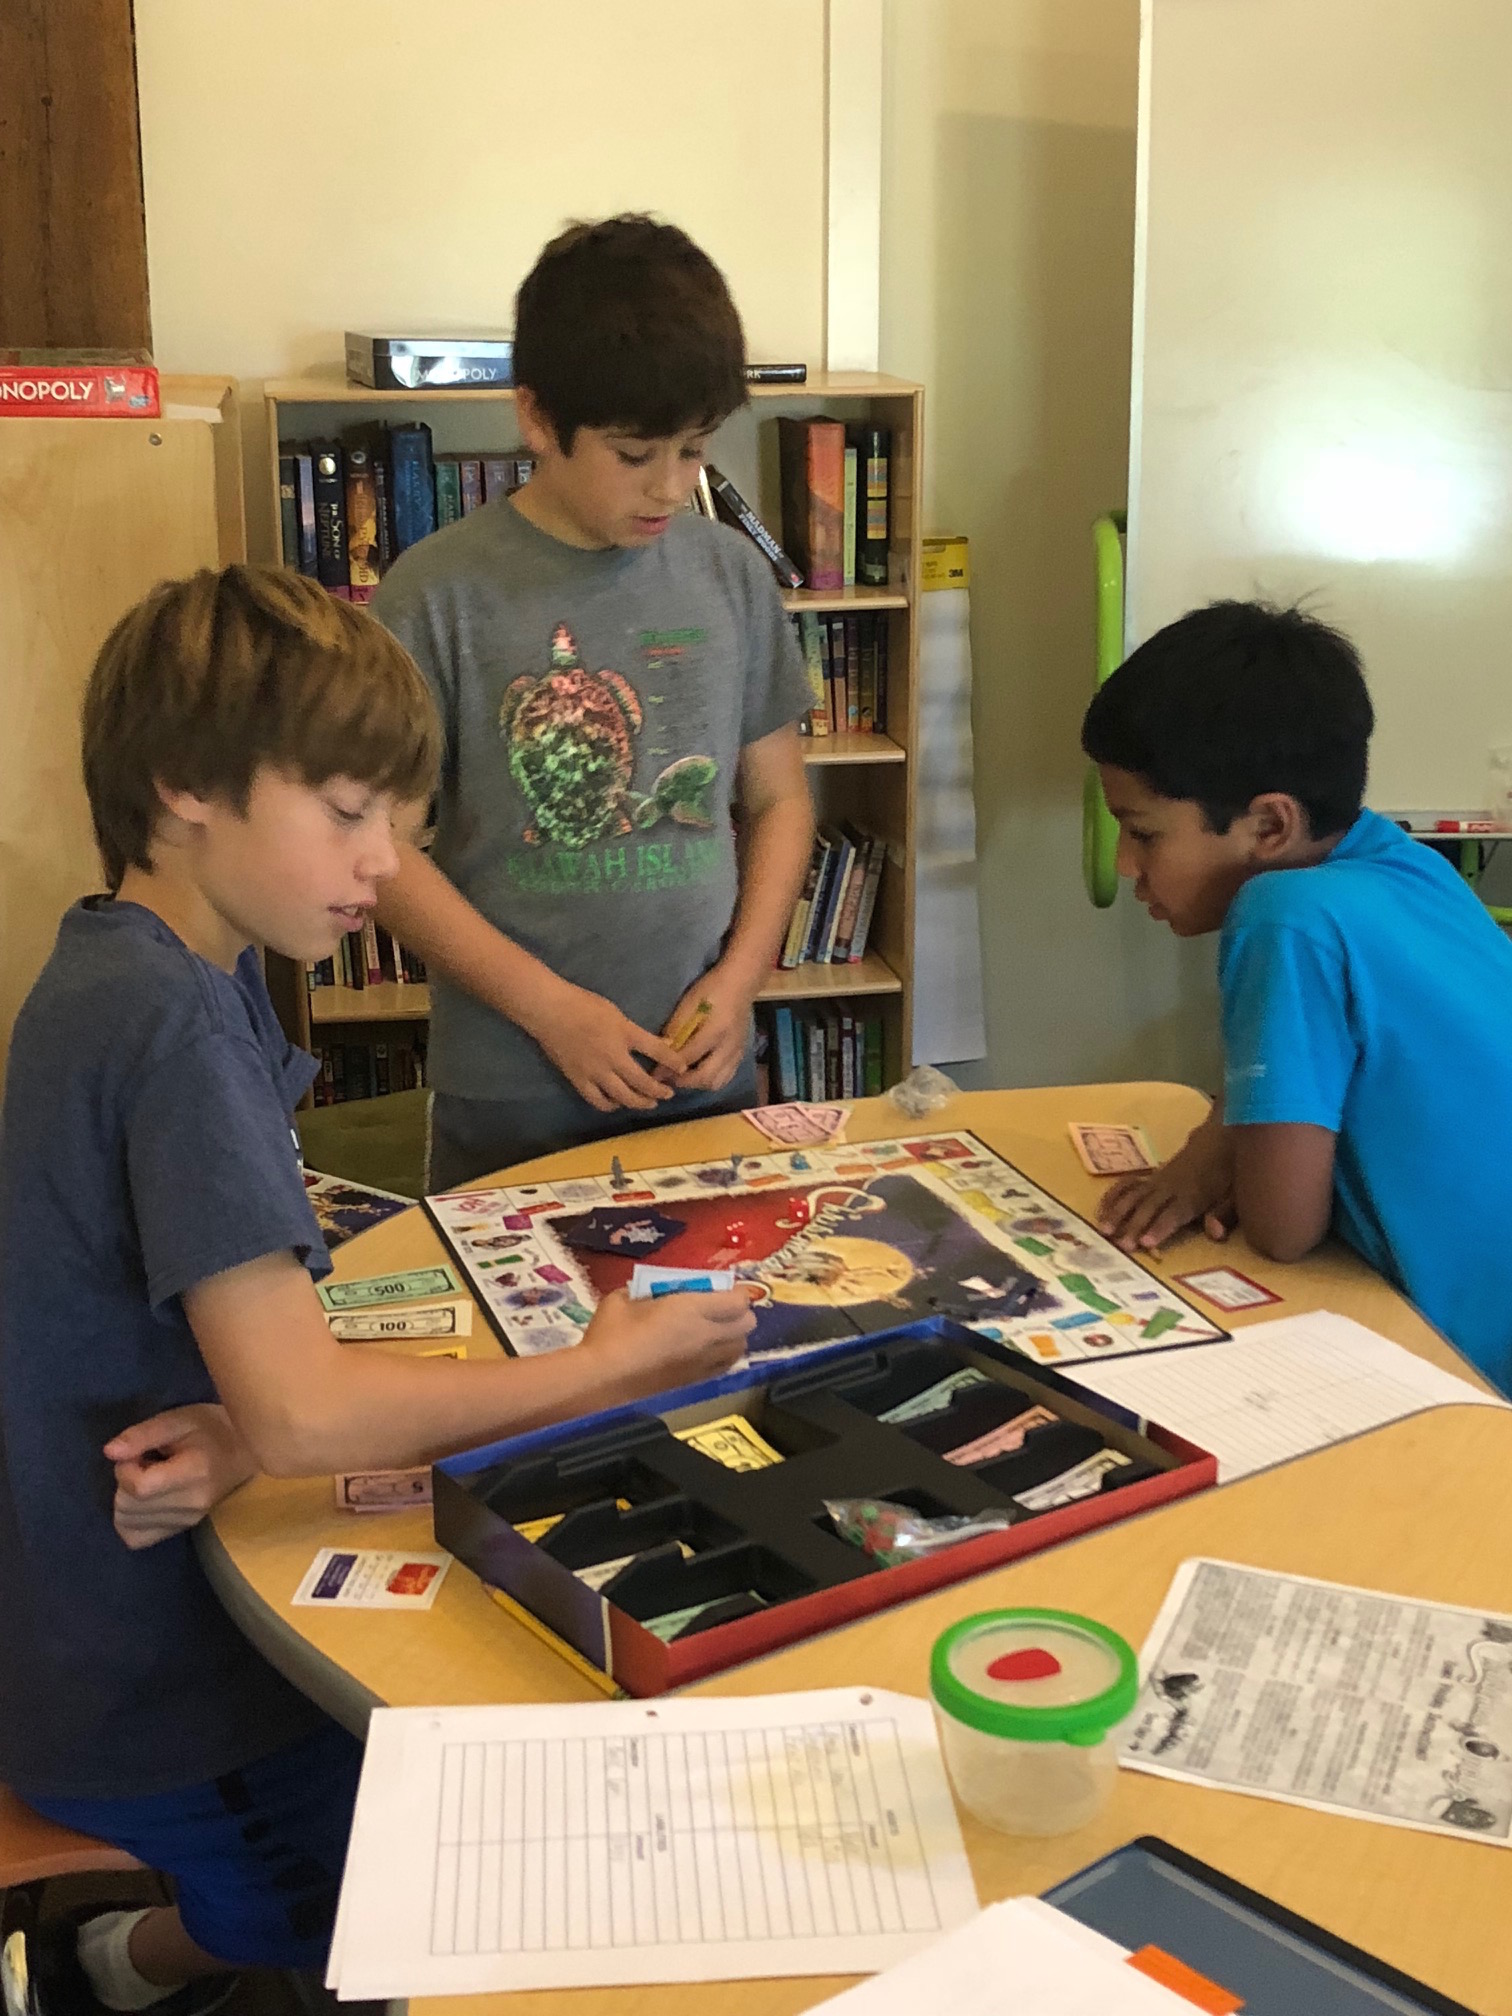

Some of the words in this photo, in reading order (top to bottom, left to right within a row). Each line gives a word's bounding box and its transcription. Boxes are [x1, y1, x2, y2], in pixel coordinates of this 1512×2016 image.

[417, 367, 497, 381] MPOLY
[745, 369, 761, 379] RK
[0, 380, 94, 401] NOPOLY
[331, 519, 343, 548] SON
[746, 511, 782, 554] MADMAN
[948, 568, 964, 578] 3M
[374, 1282, 406, 1297] 500
[379, 1321, 407, 1332] 100
